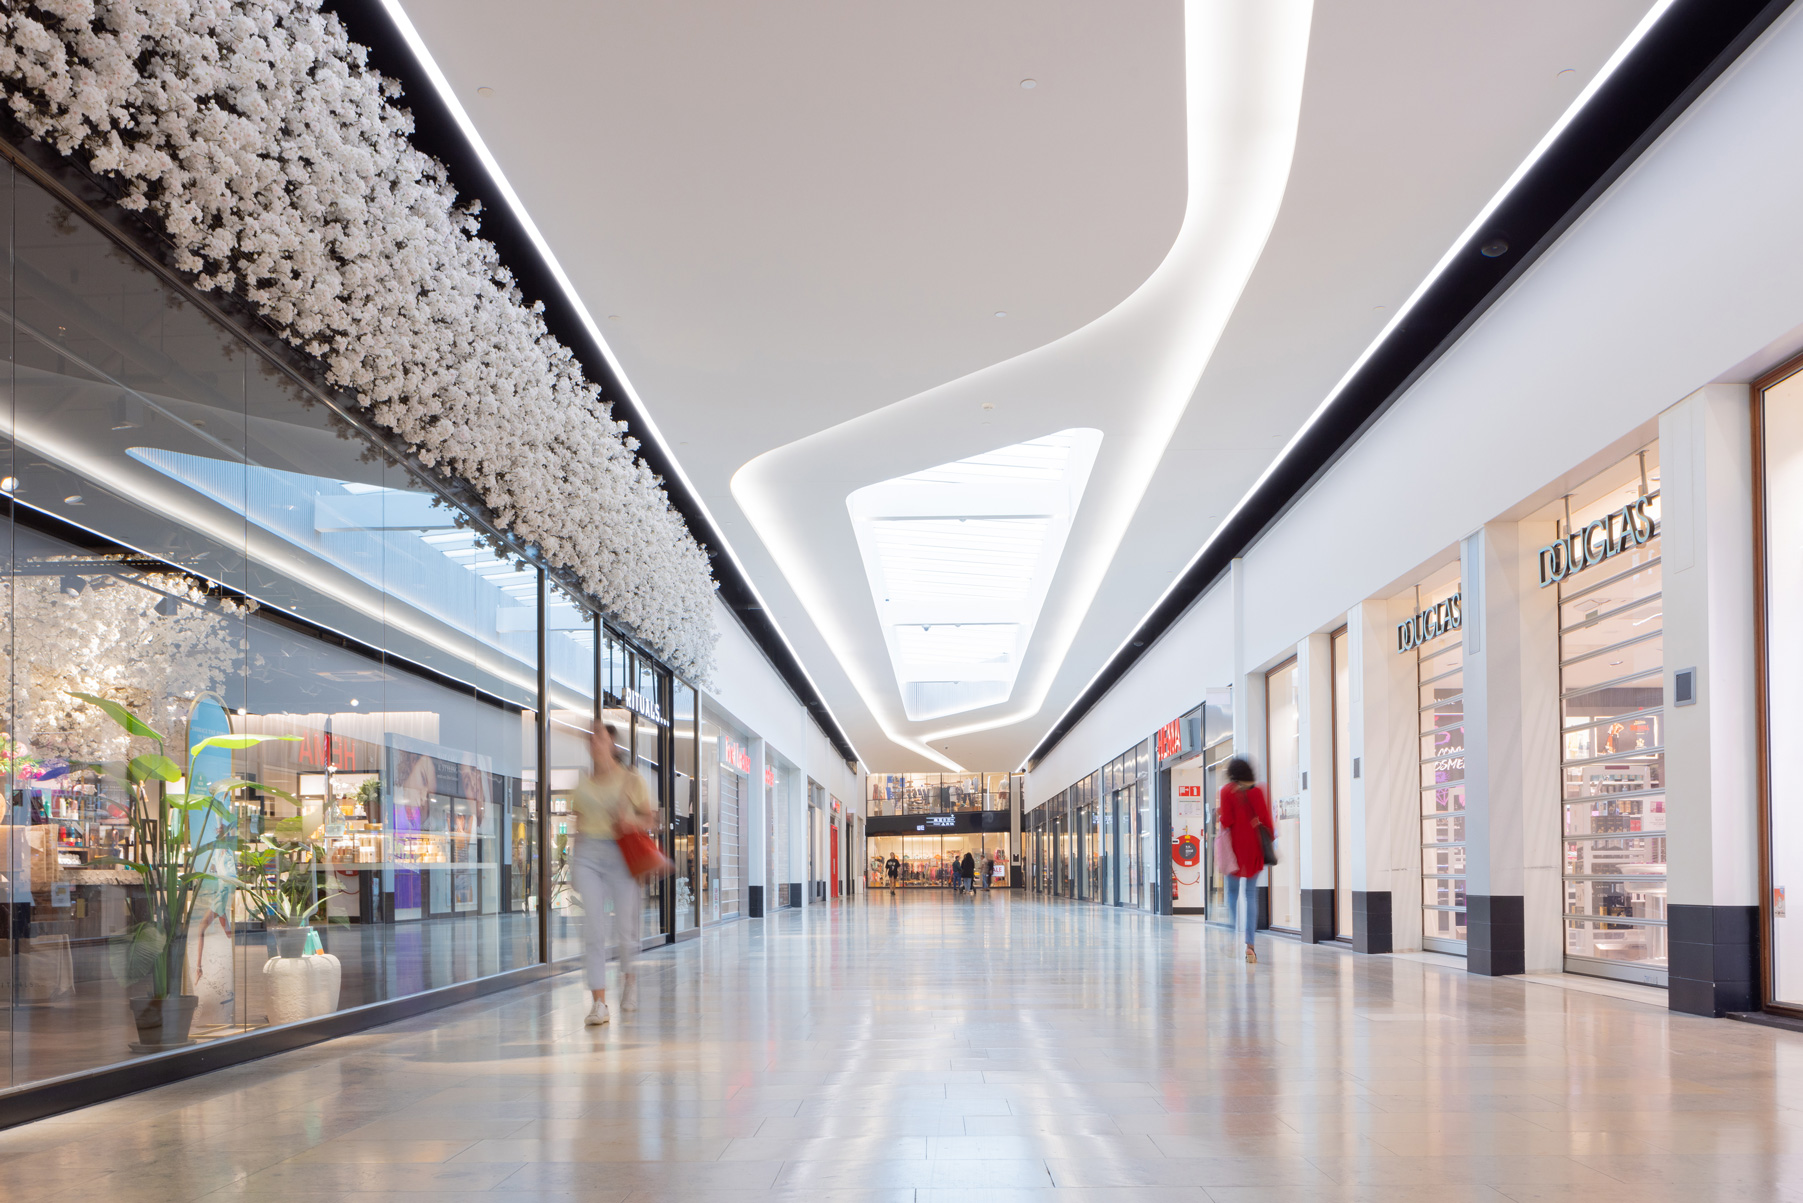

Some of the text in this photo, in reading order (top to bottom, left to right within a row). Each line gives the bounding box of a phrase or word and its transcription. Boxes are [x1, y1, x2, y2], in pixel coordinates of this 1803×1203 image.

[1538, 496, 1653, 588] DOUGLAS
[1397, 592, 1461, 653] DOUGLAS
[1158, 717, 1182, 761] HEMA
